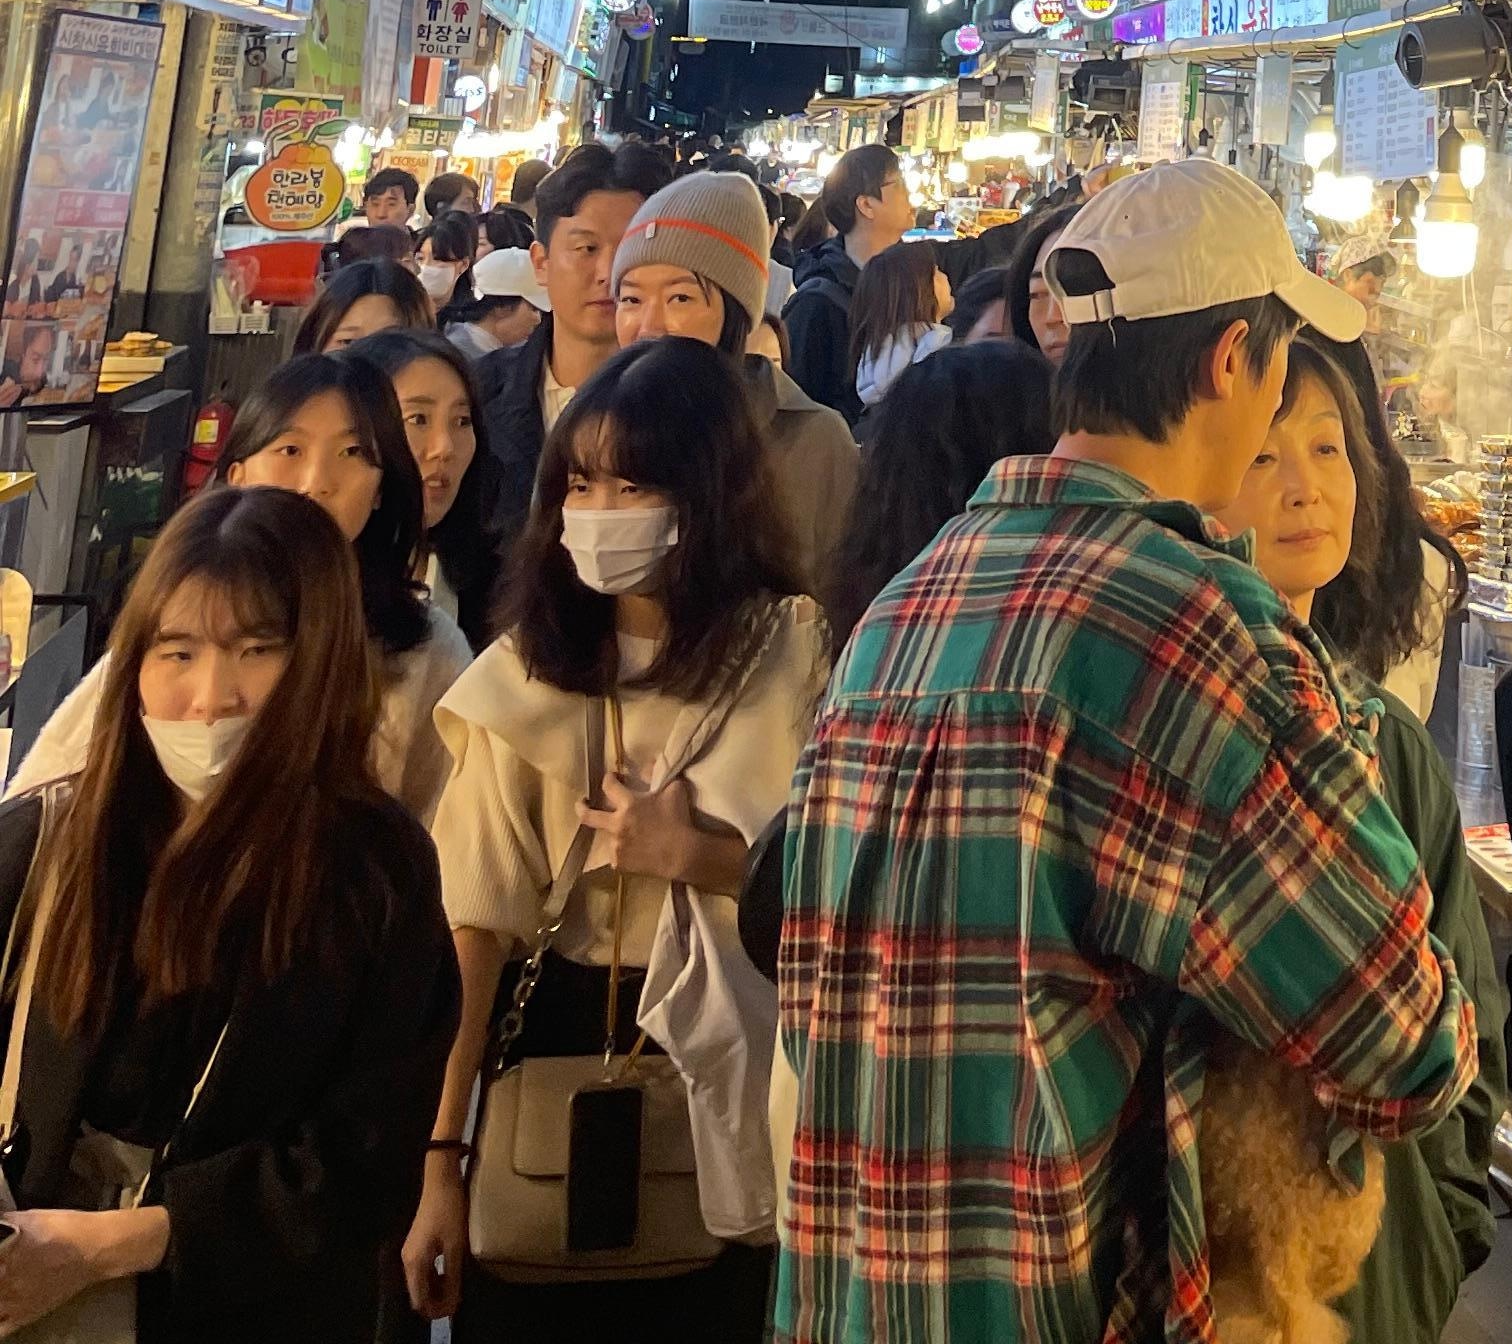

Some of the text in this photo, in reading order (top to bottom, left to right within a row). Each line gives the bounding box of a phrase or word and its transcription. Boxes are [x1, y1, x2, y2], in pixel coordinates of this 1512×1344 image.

[416, 23, 472, 44] 화장실
[419, 43, 462, 55] TOILET
[273, 168, 325, 189] 한라봉
[267, 190, 325, 209] 천혜향
